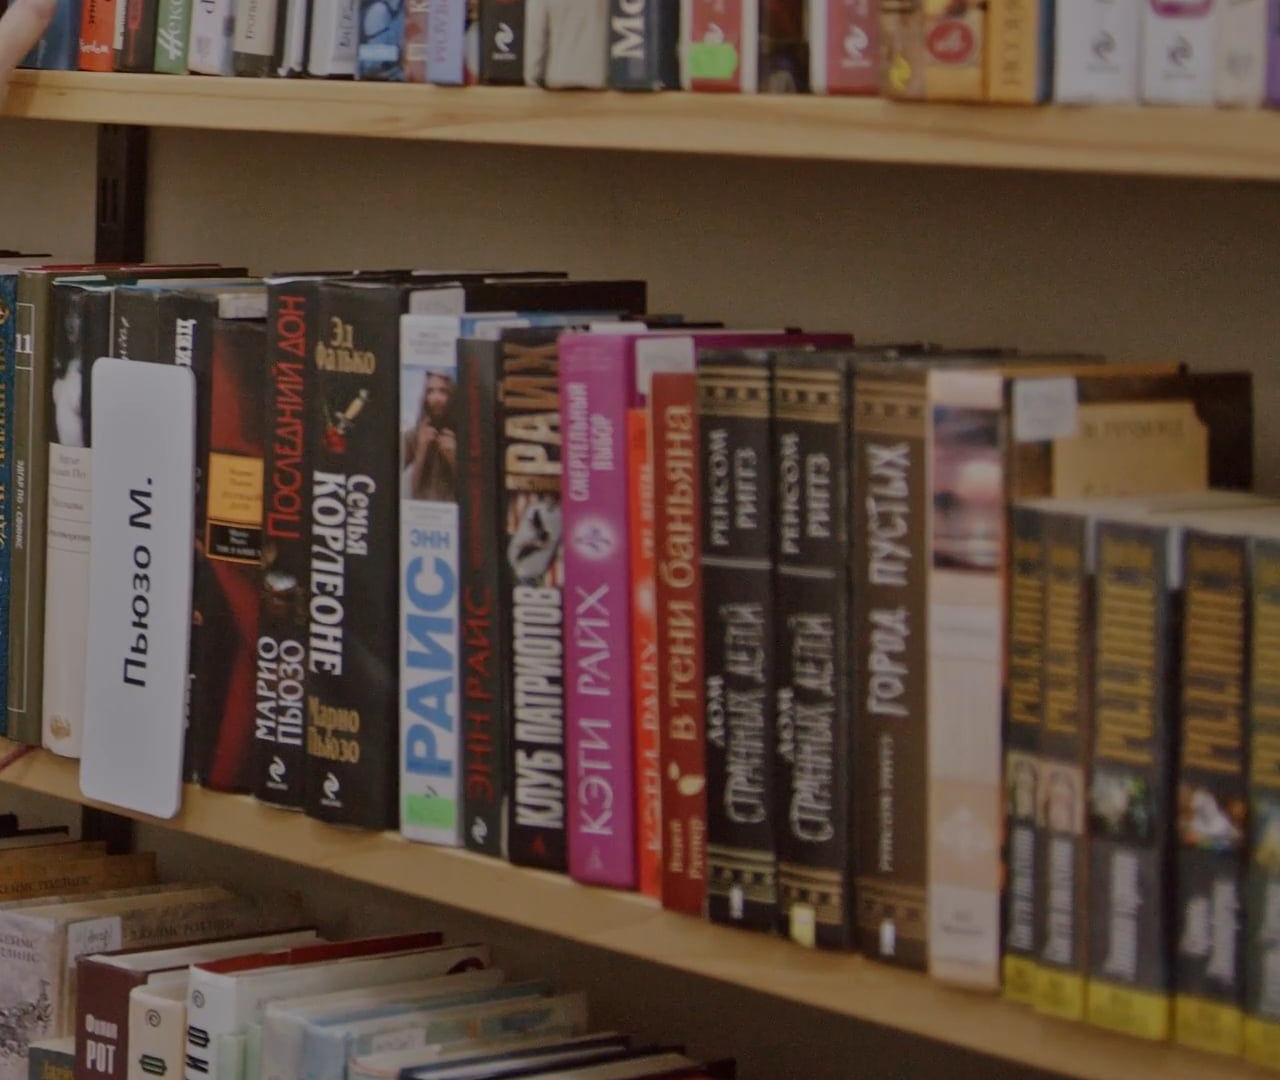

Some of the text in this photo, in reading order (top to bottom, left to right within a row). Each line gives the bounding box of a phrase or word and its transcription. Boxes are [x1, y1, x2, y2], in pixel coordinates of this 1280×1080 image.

[267, 295, 306, 539] ПОСЛЕДНИЙ ДОН
[500, 341, 562, 475] РАЙХ
[568, 381, 592, 502] СМЕРТЕЛЬНЫЙ
[590, 412, 615, 472] ВЫБОР
[345, 473, 377, 556] Семья
[410, 527, 451, 549] ЭНН
[709, 428, 731, 546] РЕНСОМ
[734, 446, 760, 530] РИГГЗ
[780, 432, 802, 555] РЕНСОМ
[806, 452, 832, 539] РИГГЗ
[121, 475, 154, 688] Пьюзо М.
[307, 469, 343, 676] КОРЛЕОНЕ
[865, 441, 912, 719] ГОРОД ПУСТЫХ
[255, 635, 280, 741] МАРИО
[278, 639, 306, 746] ПЬЮЗО
[404, 555, 454, 779] РАЙС
[464, 585, 493, 704] РАЙС
[467, 712, 495, 803] ЭНН
[513, 585, 565, 830] КЛУБ ПАТРИОТОВ
[573, 581, 614, 837] КЭТИ РАЙХ
[706, 674, 726, 748] ДОМ
[719, 601, 768, 824] СТРАННЫХ ДЕТЕЙ
[774, 686, 796, 765] ДОМ
[787, 613, 836, 843] СТРАННЫХ ДЕТЕЙ
[85, 1040, 117, 1075] РОТ
